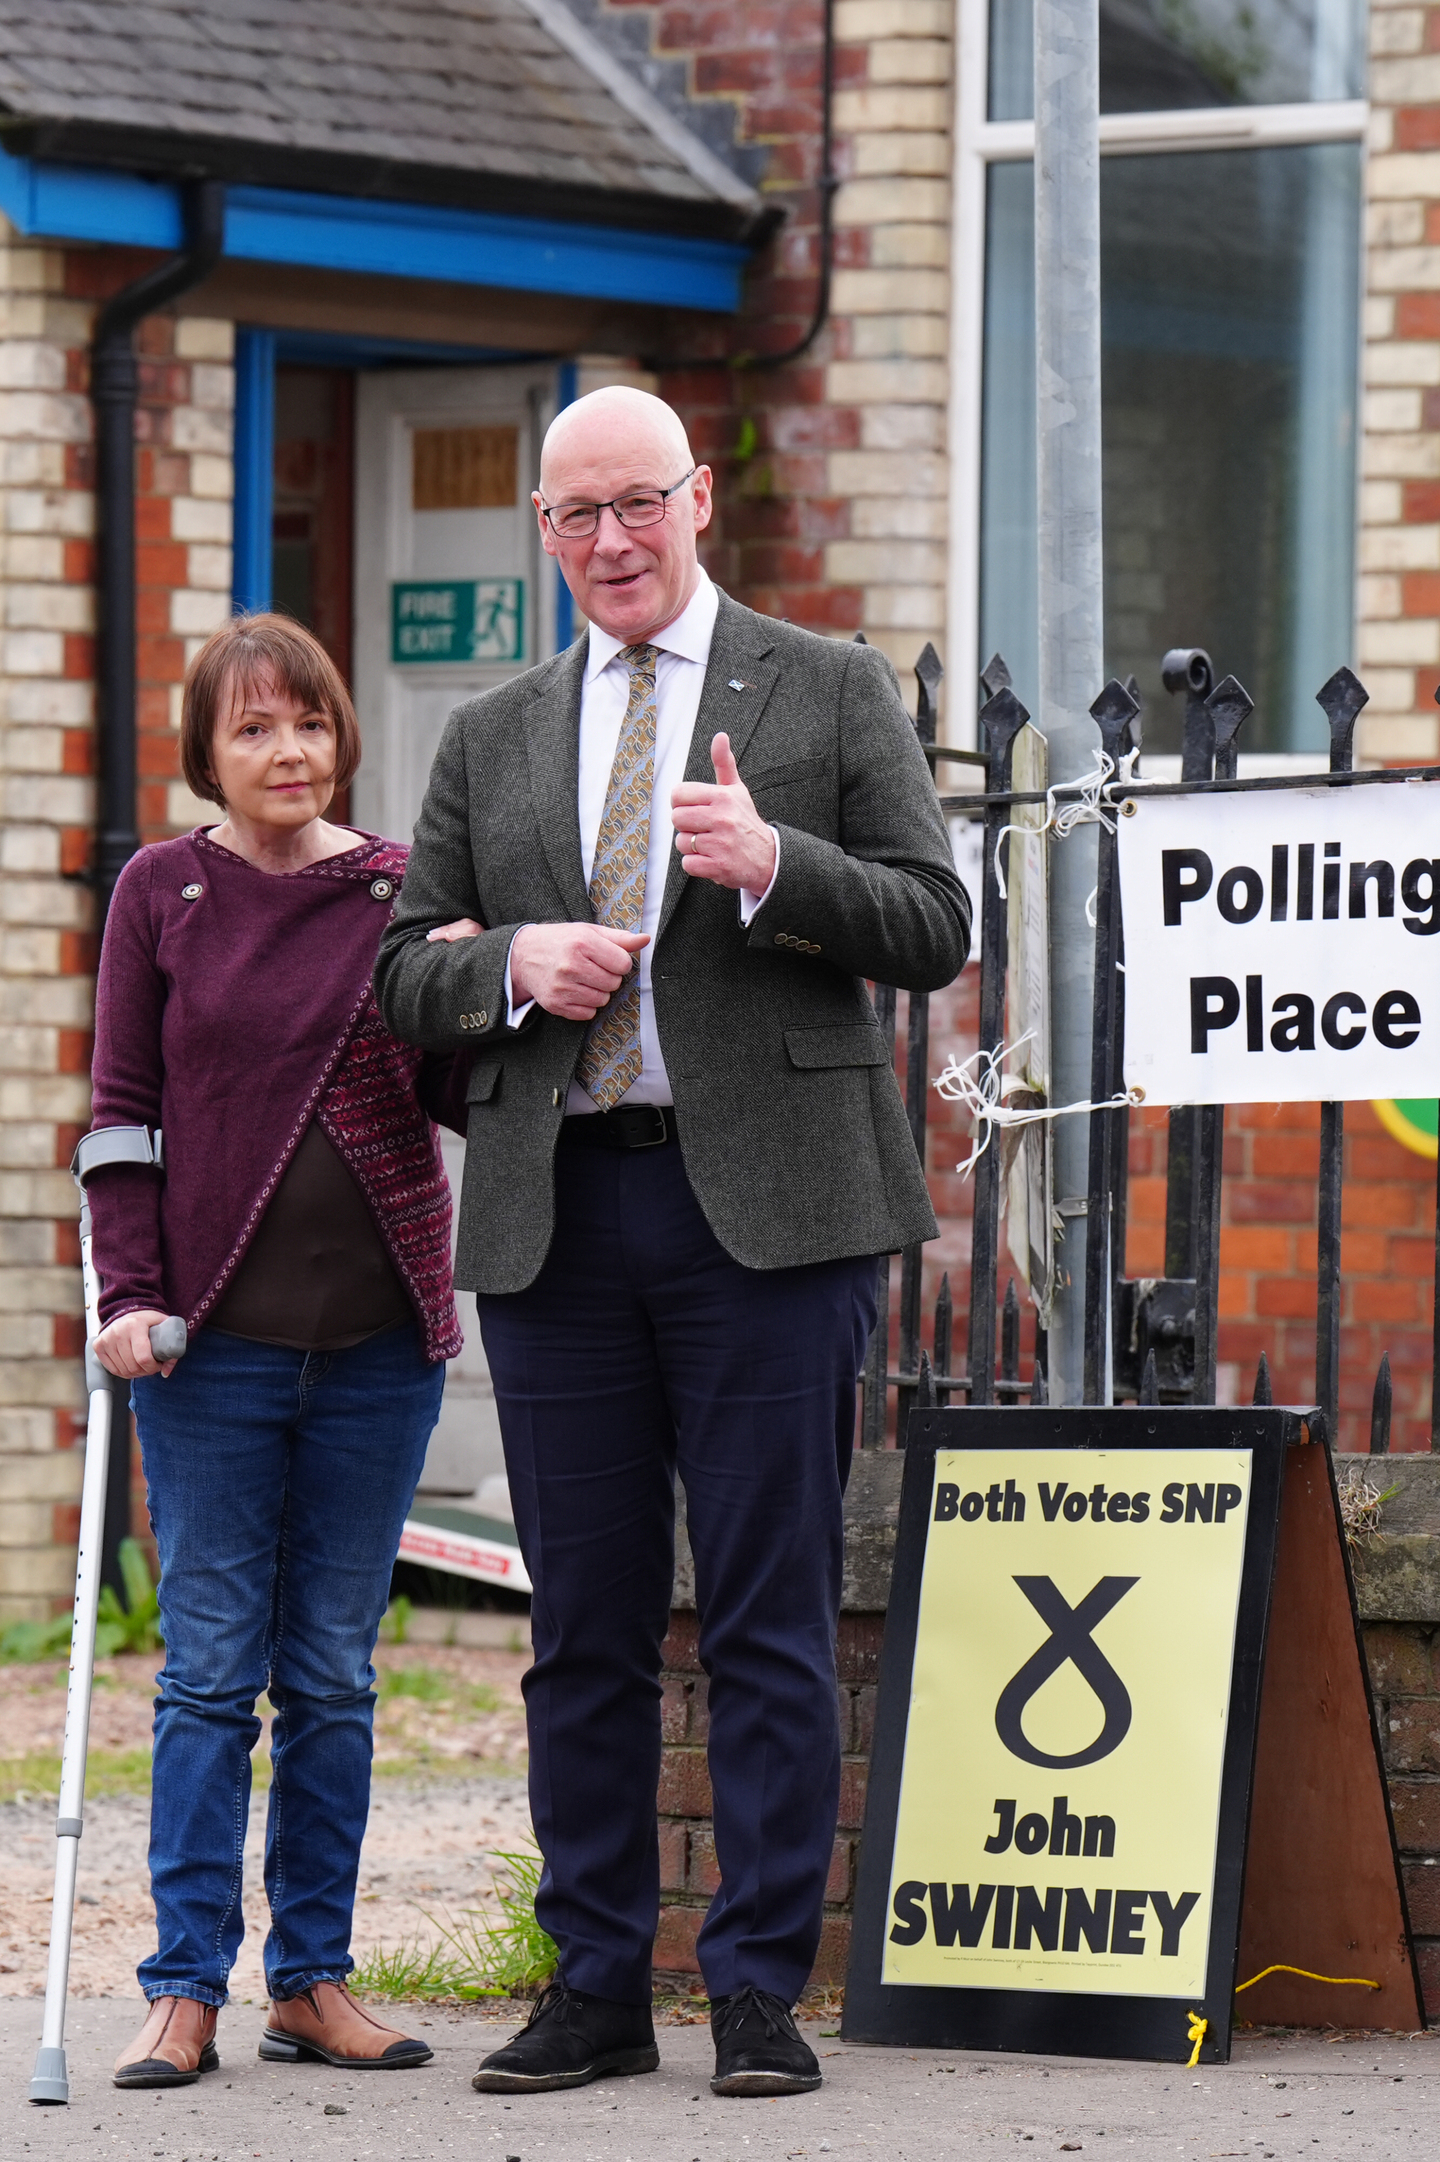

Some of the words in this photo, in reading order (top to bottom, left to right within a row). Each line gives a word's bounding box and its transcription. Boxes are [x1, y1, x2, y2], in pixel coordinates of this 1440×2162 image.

[400, 591, 456, 619] FIRE
[400, 624, 455, 653] EXIT
[1162, 842, 1440, 936] Polling
[1191, 975, 1421, 1053] Place
[934, 1479, 1025, 1522] Both
[1038, 1482, 1150, 1523] Votes
[1160, 1482, 1242, 1524] SNP
[984, 1796, 1116, 1857] John
[889, 1880, 1202, 1957] SWINNEY
